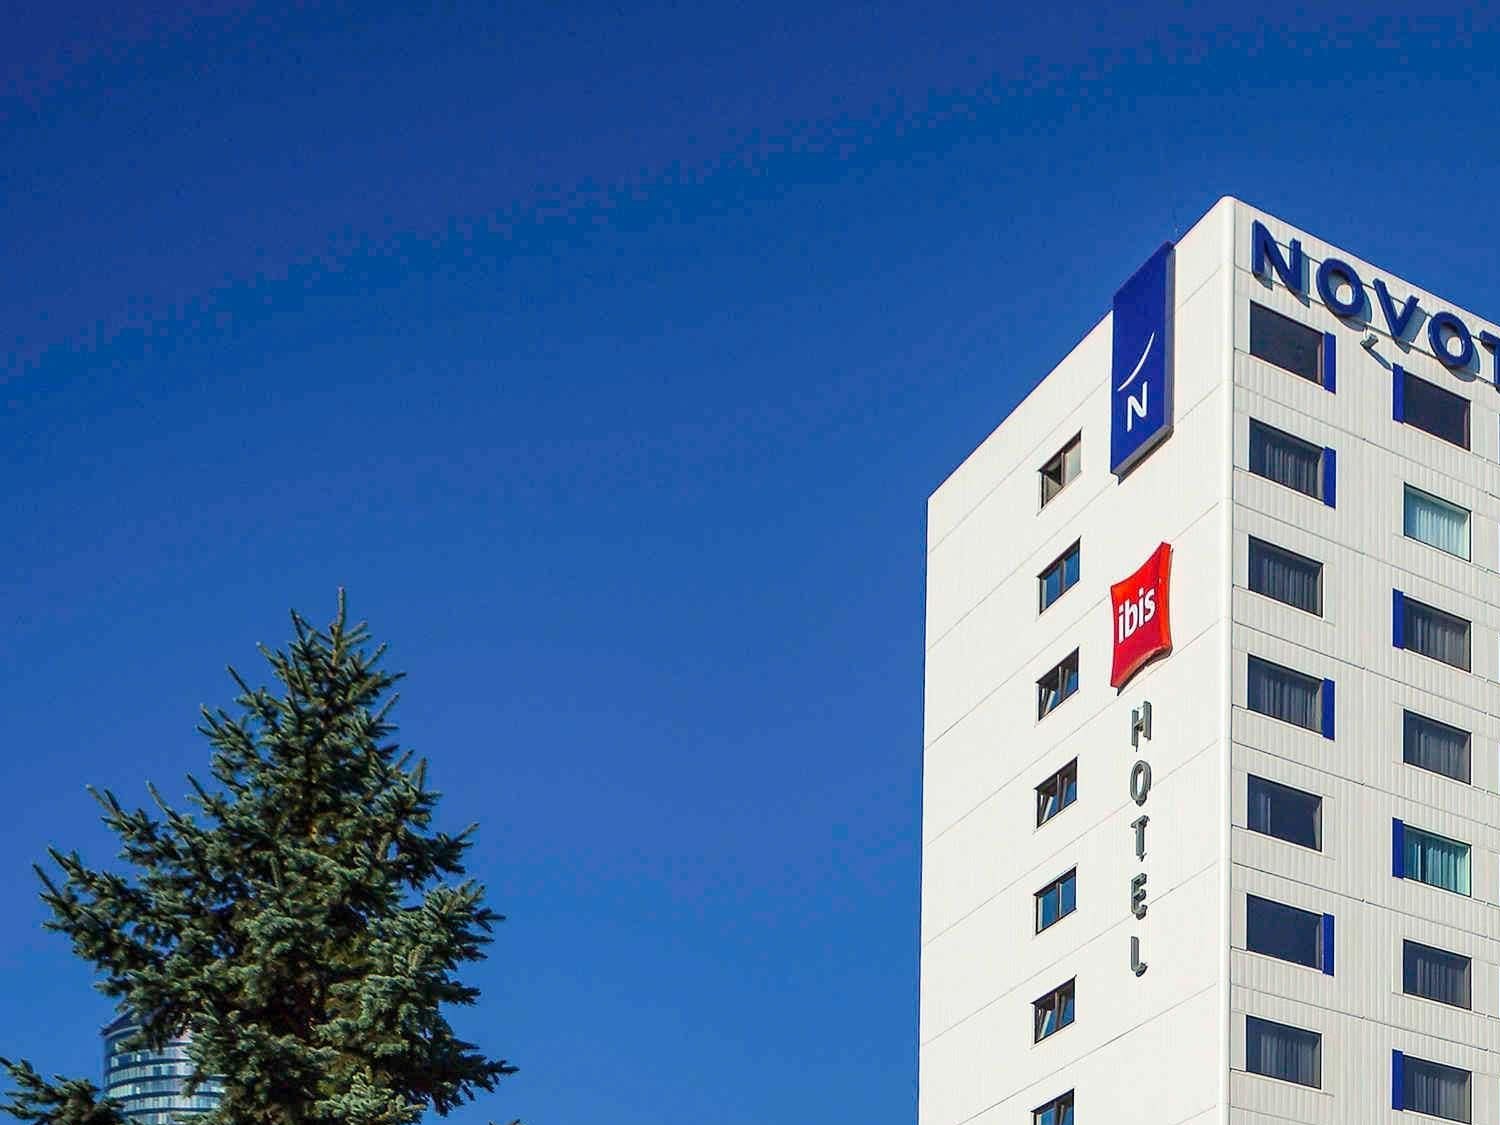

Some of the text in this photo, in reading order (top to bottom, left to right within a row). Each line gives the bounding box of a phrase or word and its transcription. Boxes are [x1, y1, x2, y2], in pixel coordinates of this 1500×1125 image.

[1127, 380, 1148, 432] N
[1118, 586, 1156, 644] ibis
[1129, 700, 1153, 978] HOTEL
